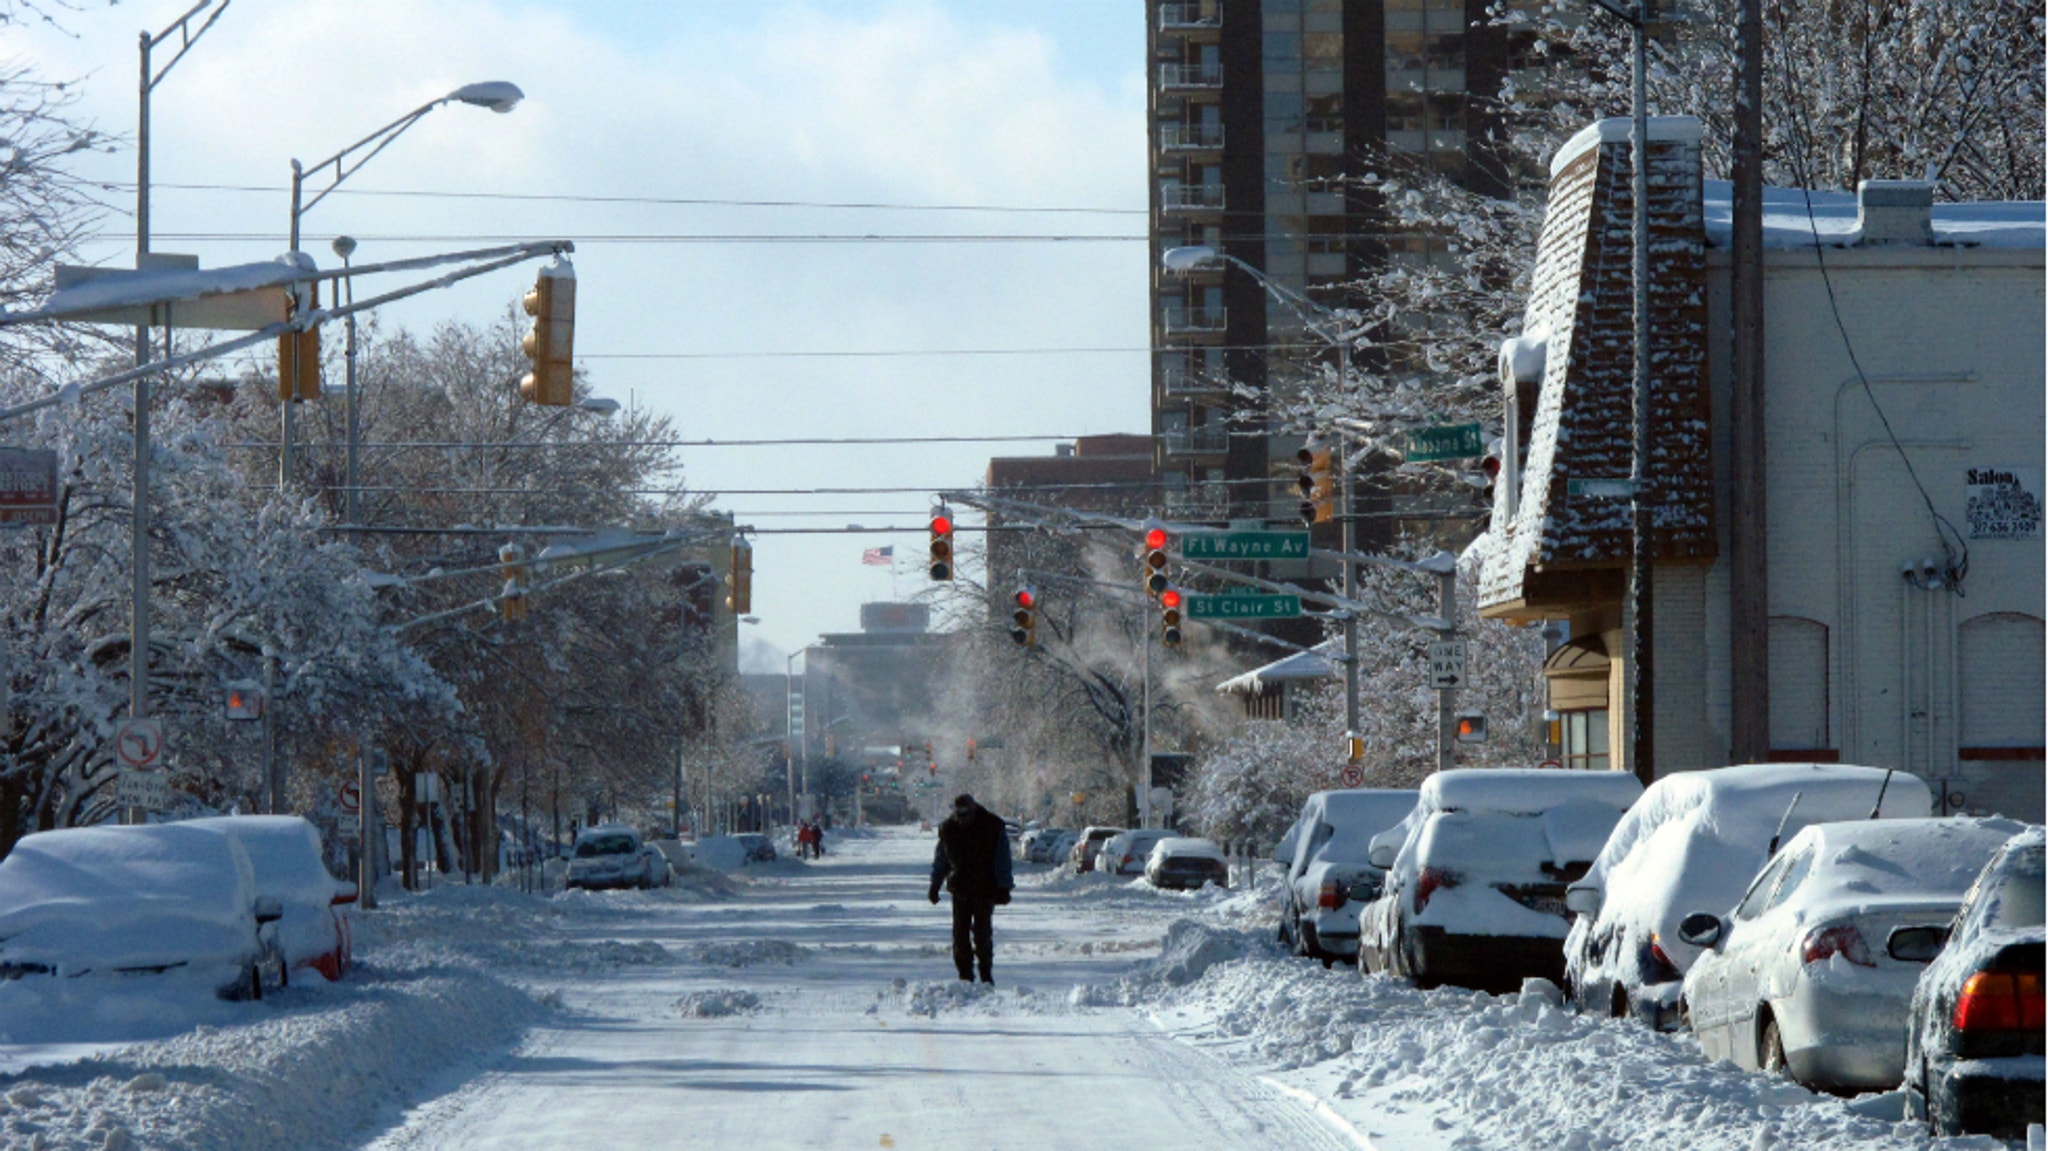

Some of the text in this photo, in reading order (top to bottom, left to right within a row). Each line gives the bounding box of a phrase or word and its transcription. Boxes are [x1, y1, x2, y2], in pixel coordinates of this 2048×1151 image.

[1968, 469, 2013, 485] Salon
[1188, 539, 1303, 555] Ft Wayne Av
[1197, 602, 1291, 613] St Clair St
[1433, 645, 1461, 656] ONE
[1433, 660, 1463, 671] WAY
